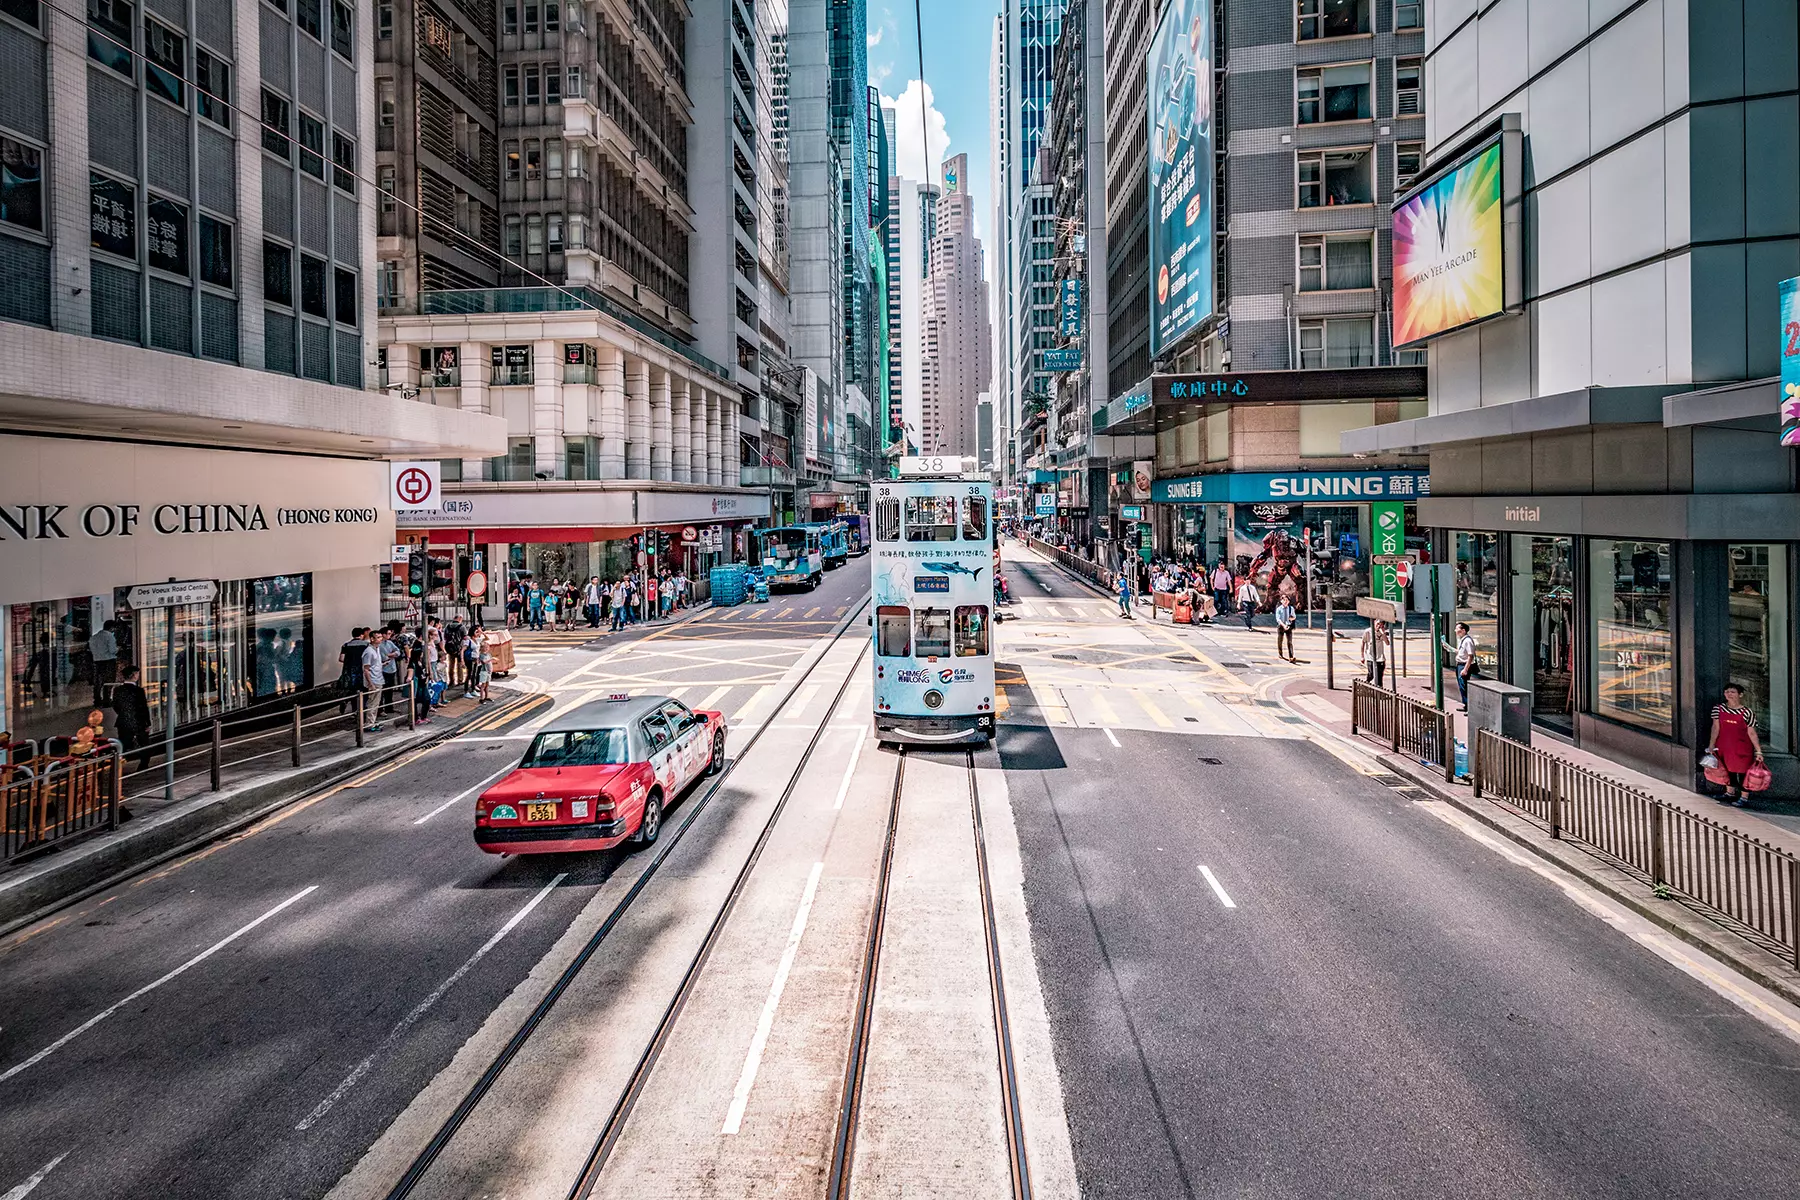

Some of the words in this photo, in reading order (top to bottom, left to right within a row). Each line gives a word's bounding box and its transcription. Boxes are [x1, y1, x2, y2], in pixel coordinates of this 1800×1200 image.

[1413, 272, 1429, 286] MAN
[1430, 265, 1443, 277] YEE
[1445, 248, 1477, 271] ARCADE
[1064, 280, 1079, 335] 日發文具
[1046, 352, 1061, 360] YAT
[1170, 380, 1249, 398] 軟庫中心
[918, 458, 943, 471] 38
[879, 487, 890, 495] 38
[968, 486, 980, 495] 38
[1167, 483, 1190, 498] SUNING
[1269, 477, 1383, 496] SUNING
[83, 505, 140, 537] OF
[154, 504, 270, 534] CHINA
[277, 507, 331, 528] (HONG
[334, 507, 378, 526] KONG)
[1505, 506, 1540, 521] initial
[1382, 533, 1397, 571] XBX
[138, 588, 150, 596] Des
[188, 583, 209, 591] Central
[979, 717, 990, 726] 38
[630, 778, 641, 792] 的士
[530, 811, 554, 820] 6361
